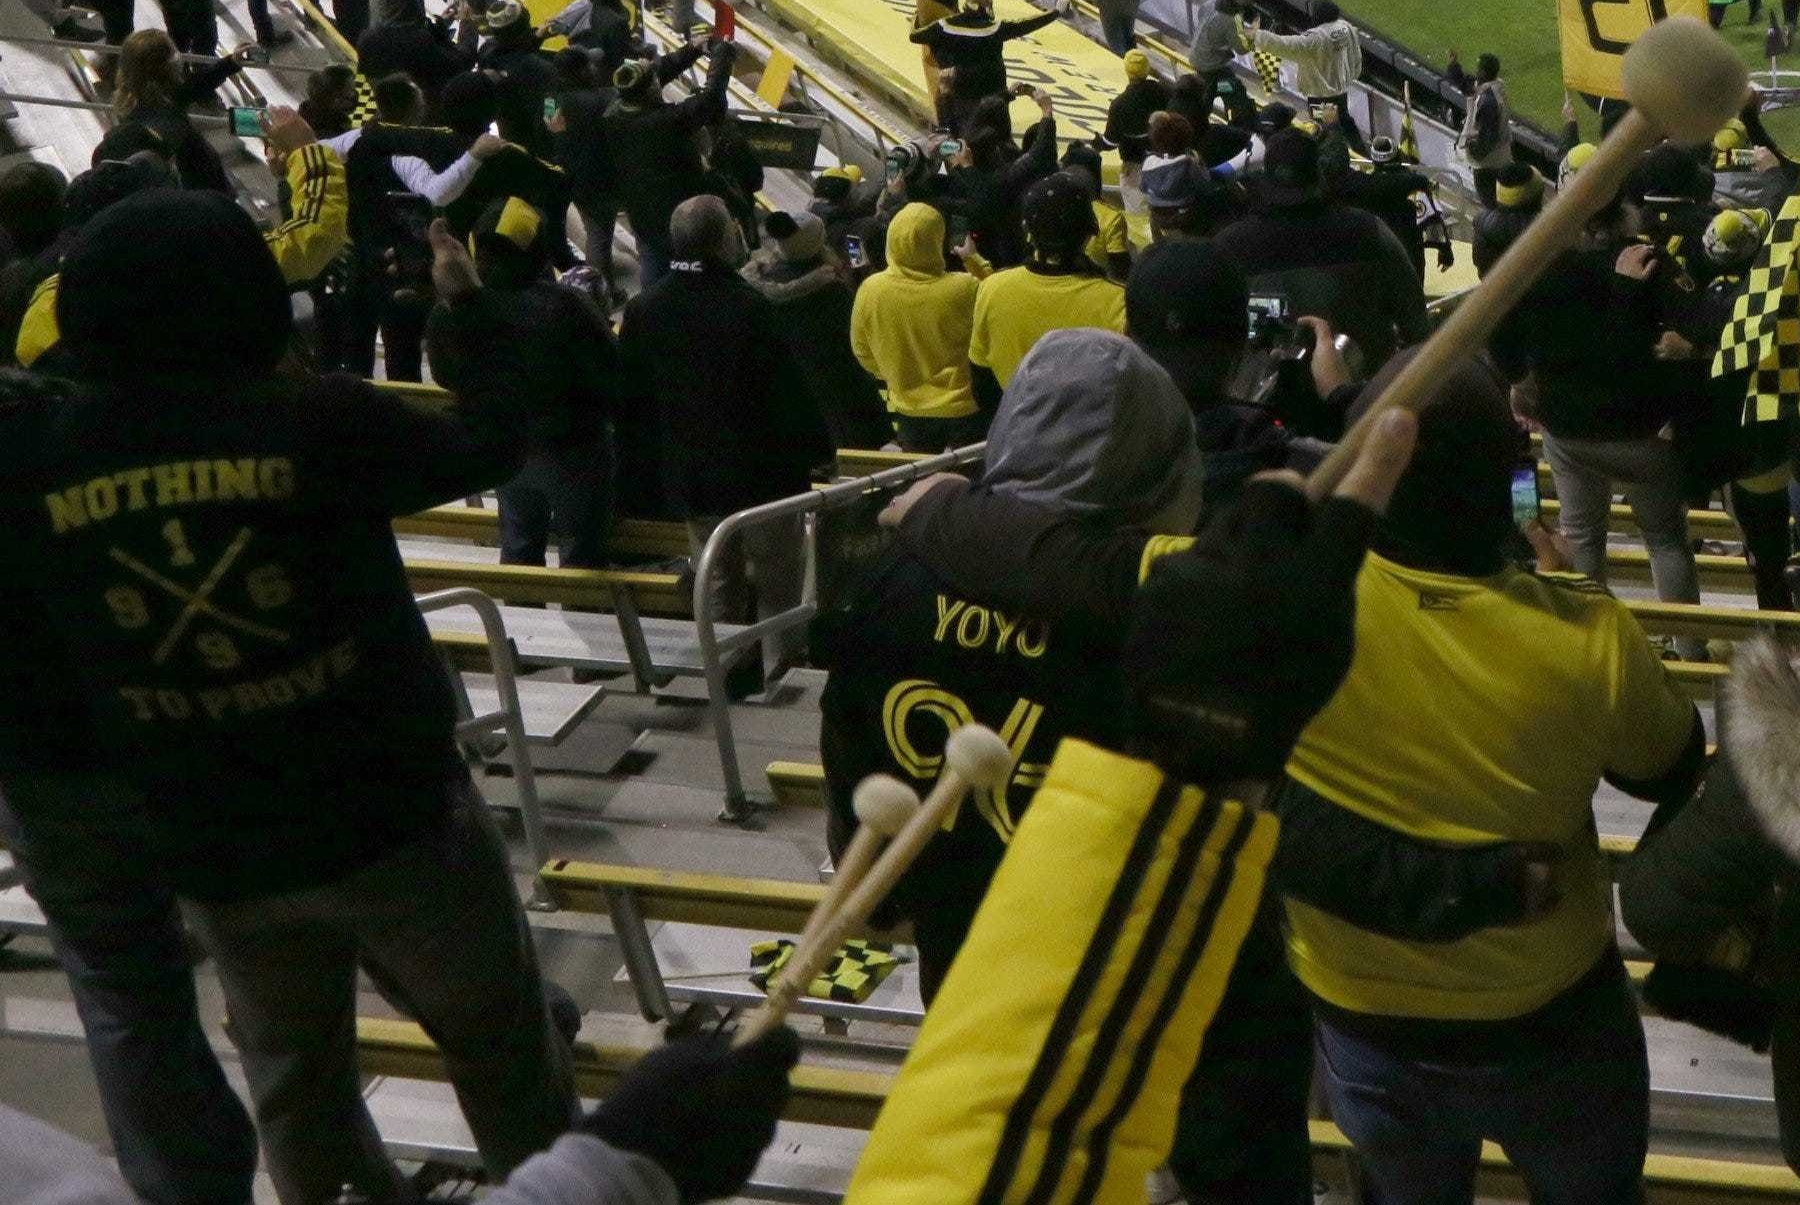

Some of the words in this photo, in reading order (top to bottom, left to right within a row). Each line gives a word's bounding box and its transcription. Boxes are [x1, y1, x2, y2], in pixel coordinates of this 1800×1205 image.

[46, 456, 298, 534] NOTHING
[162, 518, 196, 566] 1
[934, 595, 1048, 657] YOYO
[118, 685, 191, 722] TO
[198, 637, 360, 721] PROVE
